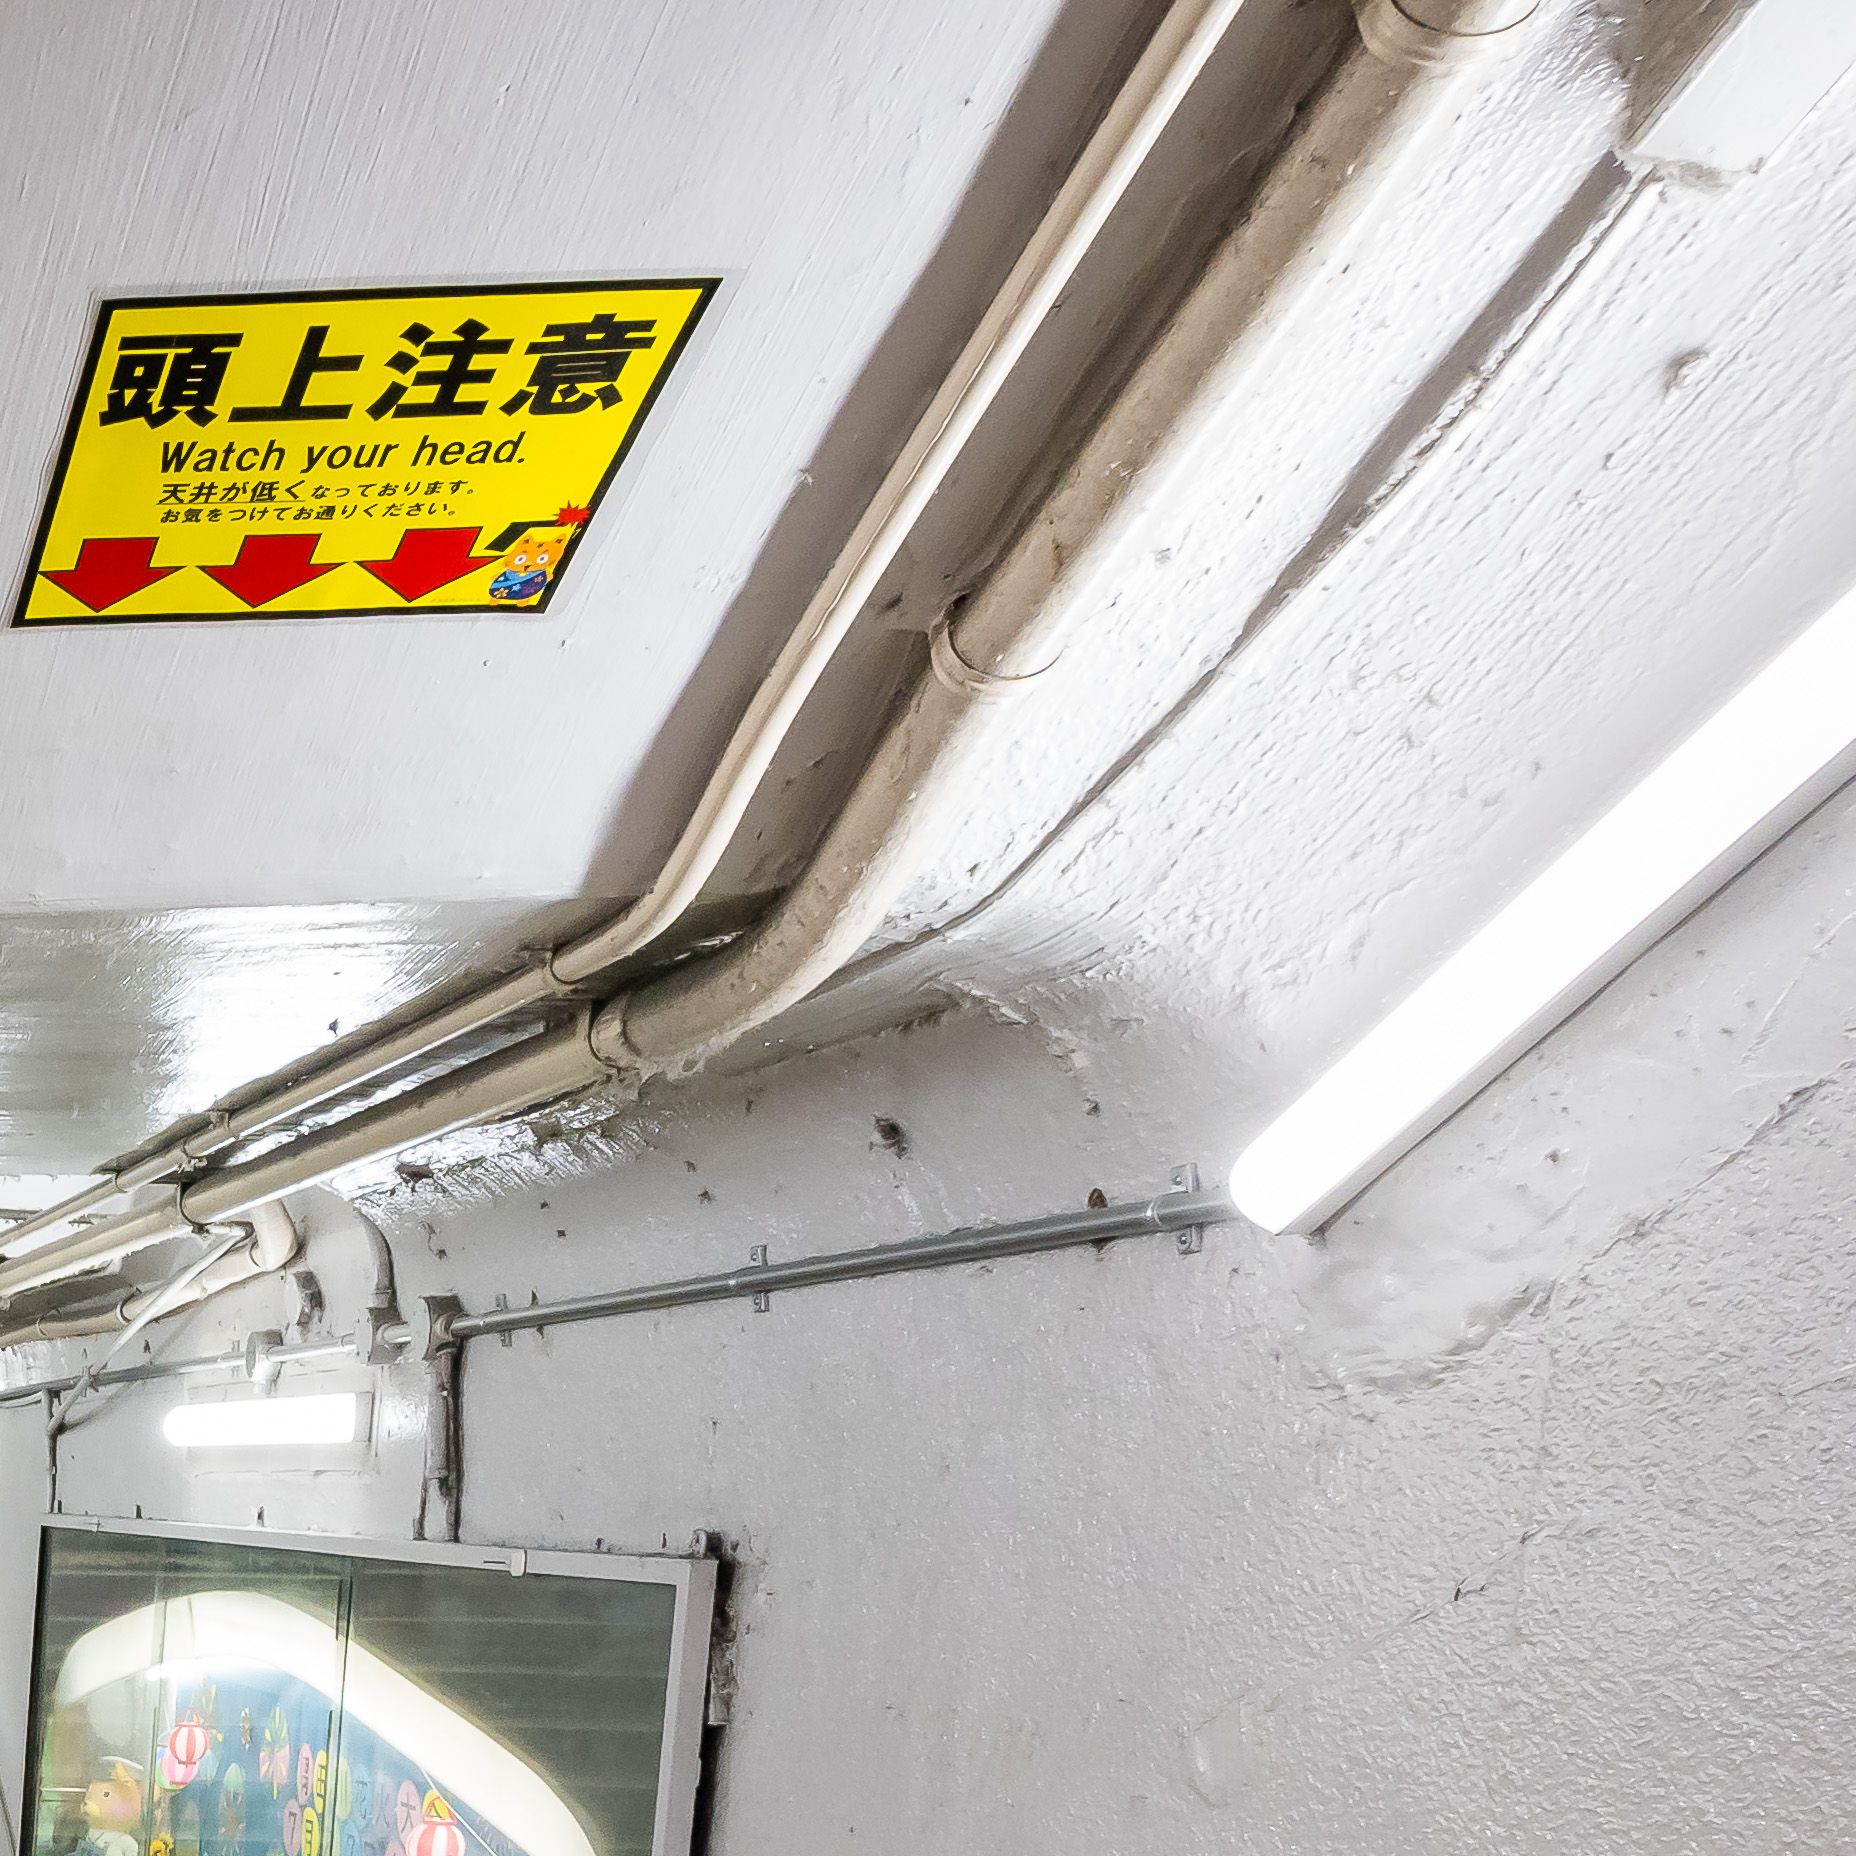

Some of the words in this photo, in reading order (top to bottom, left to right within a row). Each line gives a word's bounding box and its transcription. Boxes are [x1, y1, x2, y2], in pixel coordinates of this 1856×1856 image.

[99, 311, 657, 429] 頭上注意
[160, 439, 286, 473] Watch
[300, 442, 399, 474] your
[410, 431, 527, 467] head.
[159, 479, 475, 503] 天井が低くなっております。
[159, 502, 456, 524] お気をつけてお通りください。
